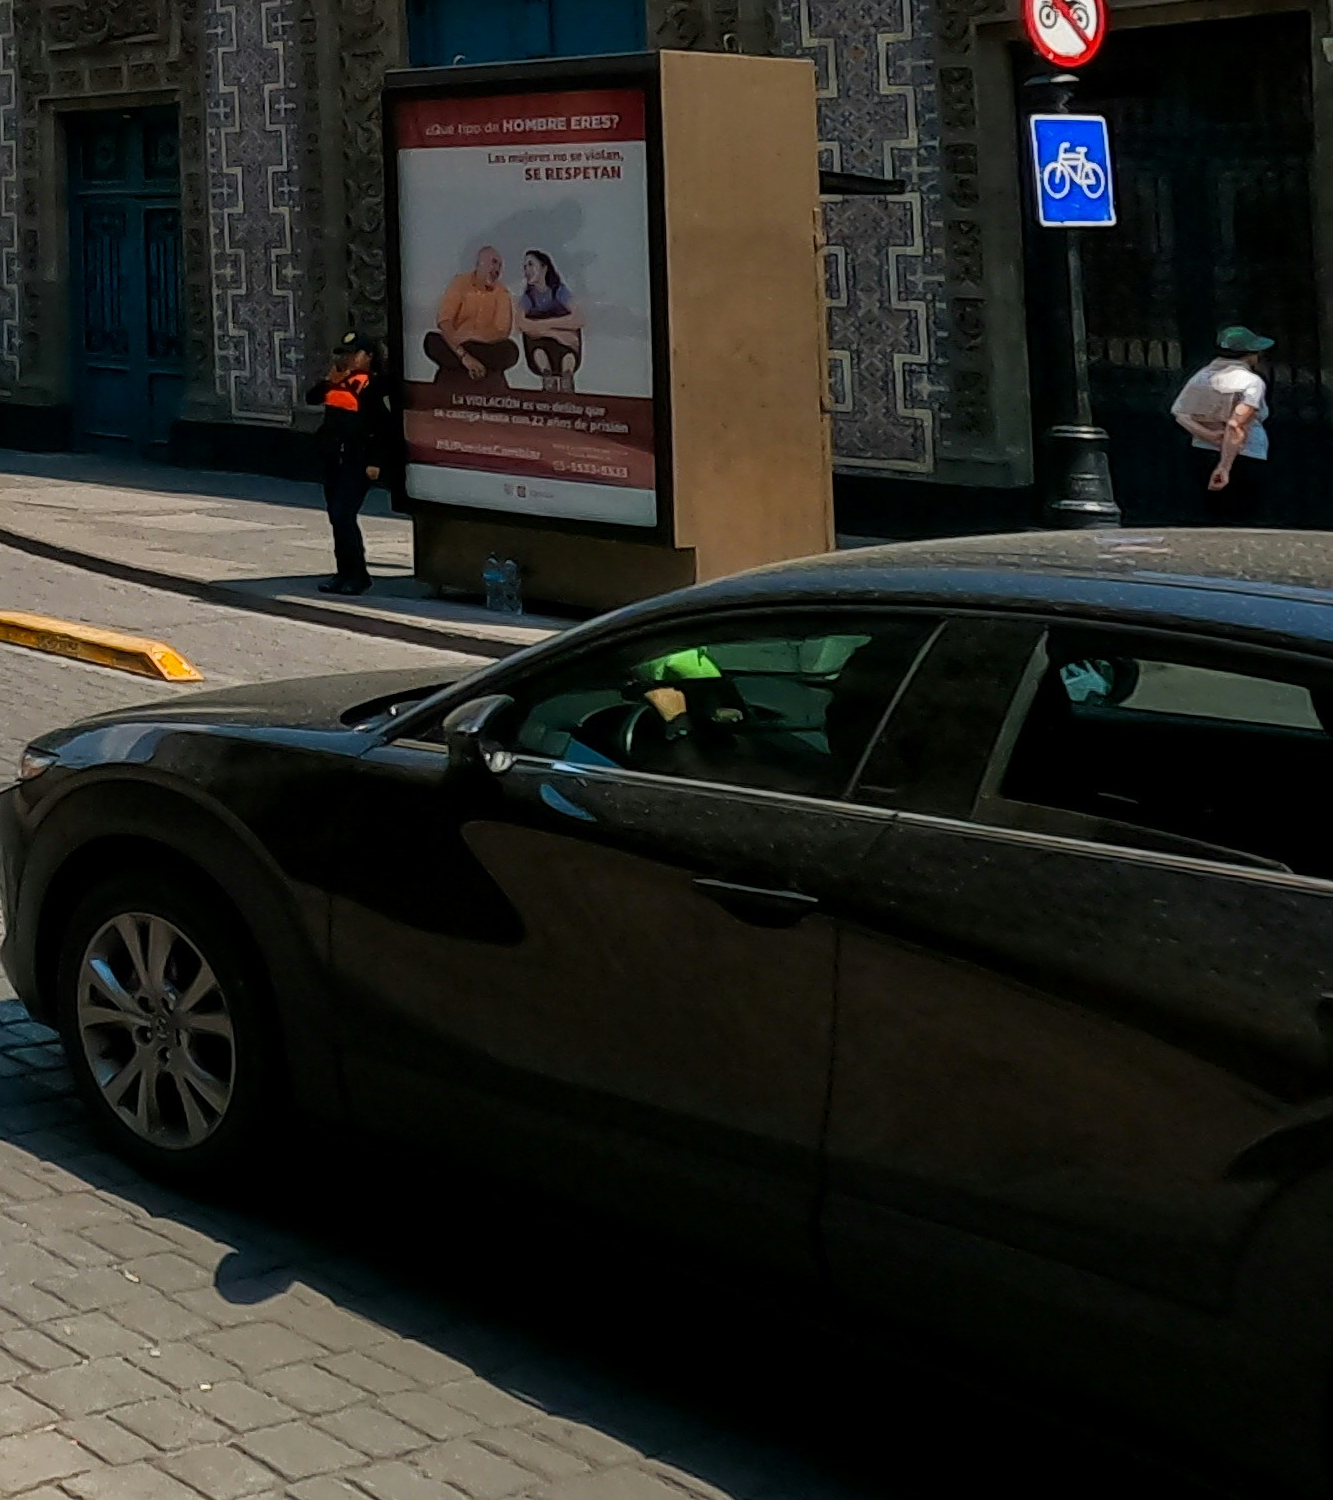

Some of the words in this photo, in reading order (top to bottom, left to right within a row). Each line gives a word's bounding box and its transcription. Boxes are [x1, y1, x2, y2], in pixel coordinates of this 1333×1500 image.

[503, 117, 567, 133] HOMBRE
[570, 114, 620, 130] ERES?
[488, 153, 505, 164] Las
[508, 152, 550, 164] mujeres
[553, 153, 567, 162] no
[570, 152, 582, 161] se
[586, 149, 624, 161] violan,
[524, 167, 541, 181] SE
[545, 165, 622, 180] RESPETAN
[452, 394, 464, 405] La
[465, 395, 521, 409] VIOLACIÓN
[585, 406, 606, 417] que
